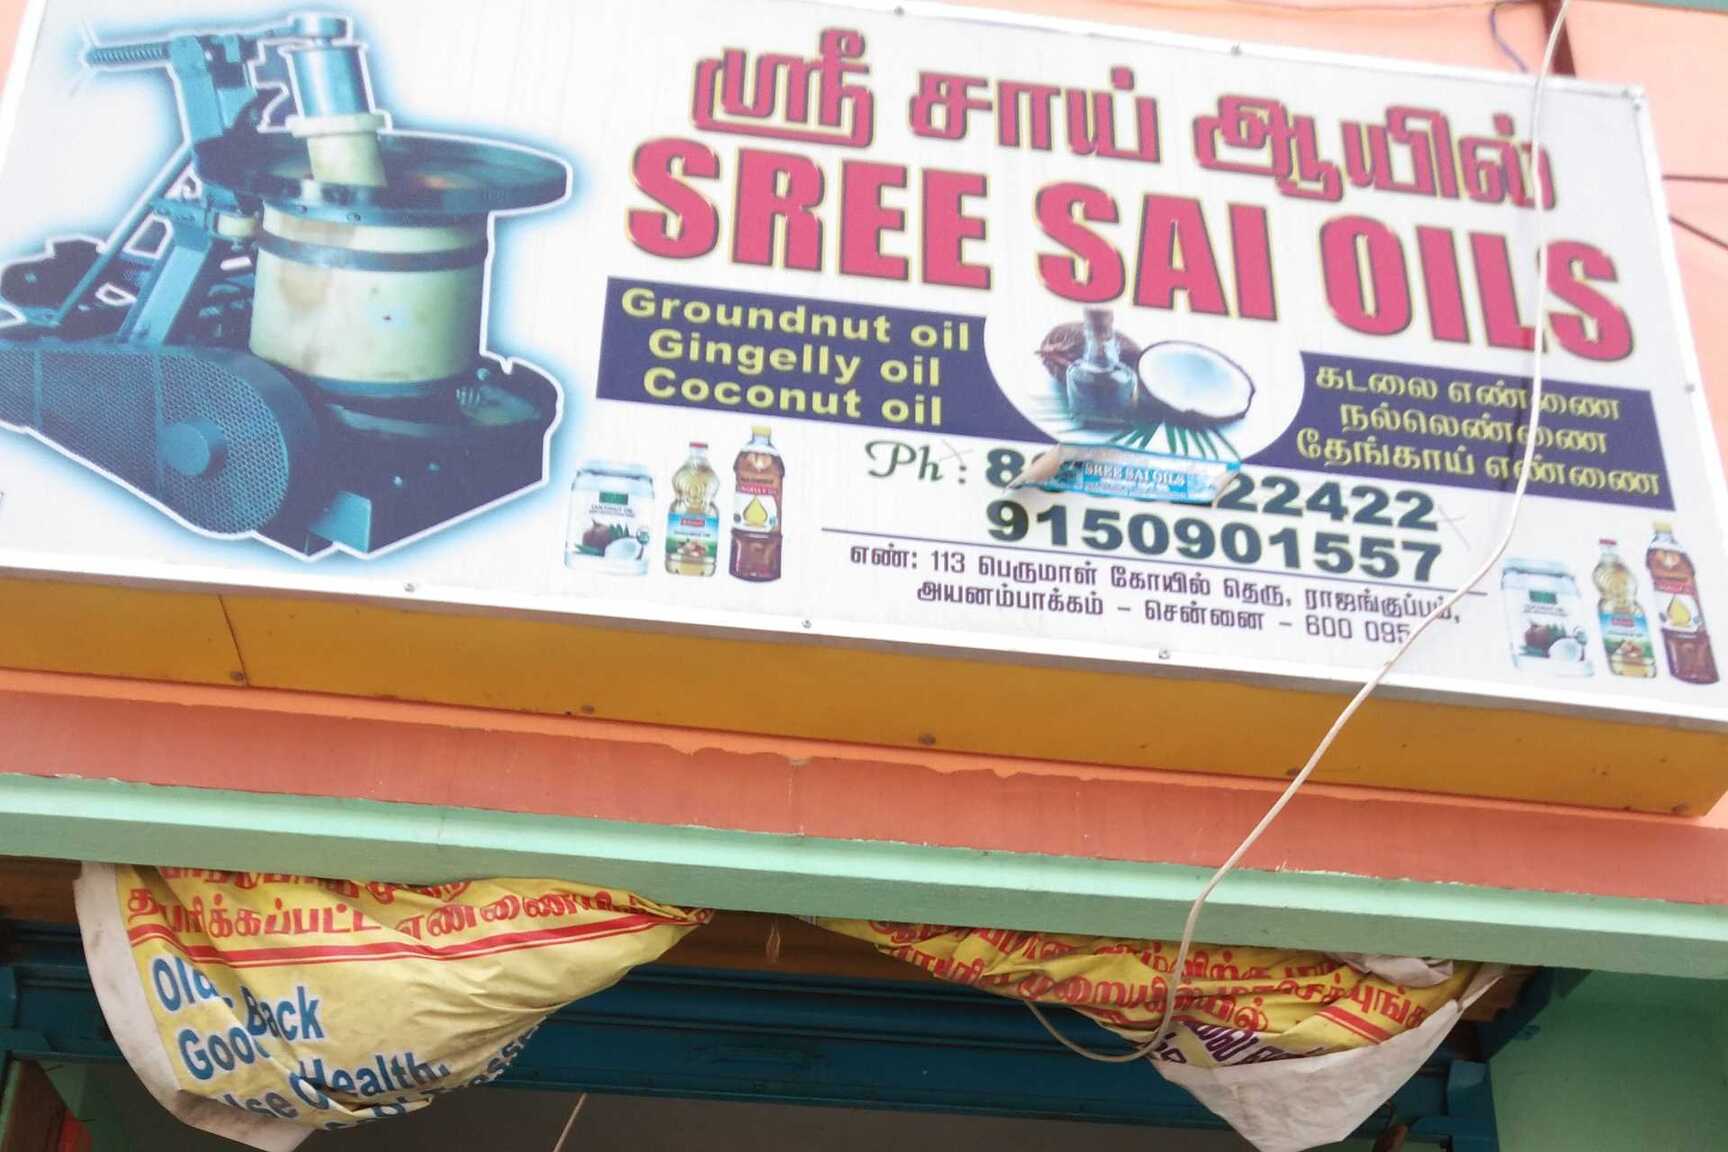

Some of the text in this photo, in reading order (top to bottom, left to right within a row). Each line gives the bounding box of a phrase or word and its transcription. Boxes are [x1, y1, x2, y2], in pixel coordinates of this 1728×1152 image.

[908, 66, 1161, 163] சாய்
[1192, 95, 1557, 210] ஆயில்
[626, 137, 1634, 362] SREE SAI OILS
[621, 287, 970, 352] Groundnut oil
[648, 328, 941, 386] Gingelly oil
[1315, 366, 1439, 400] கடலை
[643, 366, 942, 426] Coconut oil
[1295, 427, 1476, 470] தேங்காய்
[985, 446, 1439, 532] 822422
[985, 499, 1443, 583] 9150901557
[931, 550, 965, 573] 113
[978, 555, 1098, 586] பெருமாள்
[1111, 564, 1211, 597] கோயில்
[1305, 616, 1353, 640] 600
[178, 1028, 271, 1081] Goo
